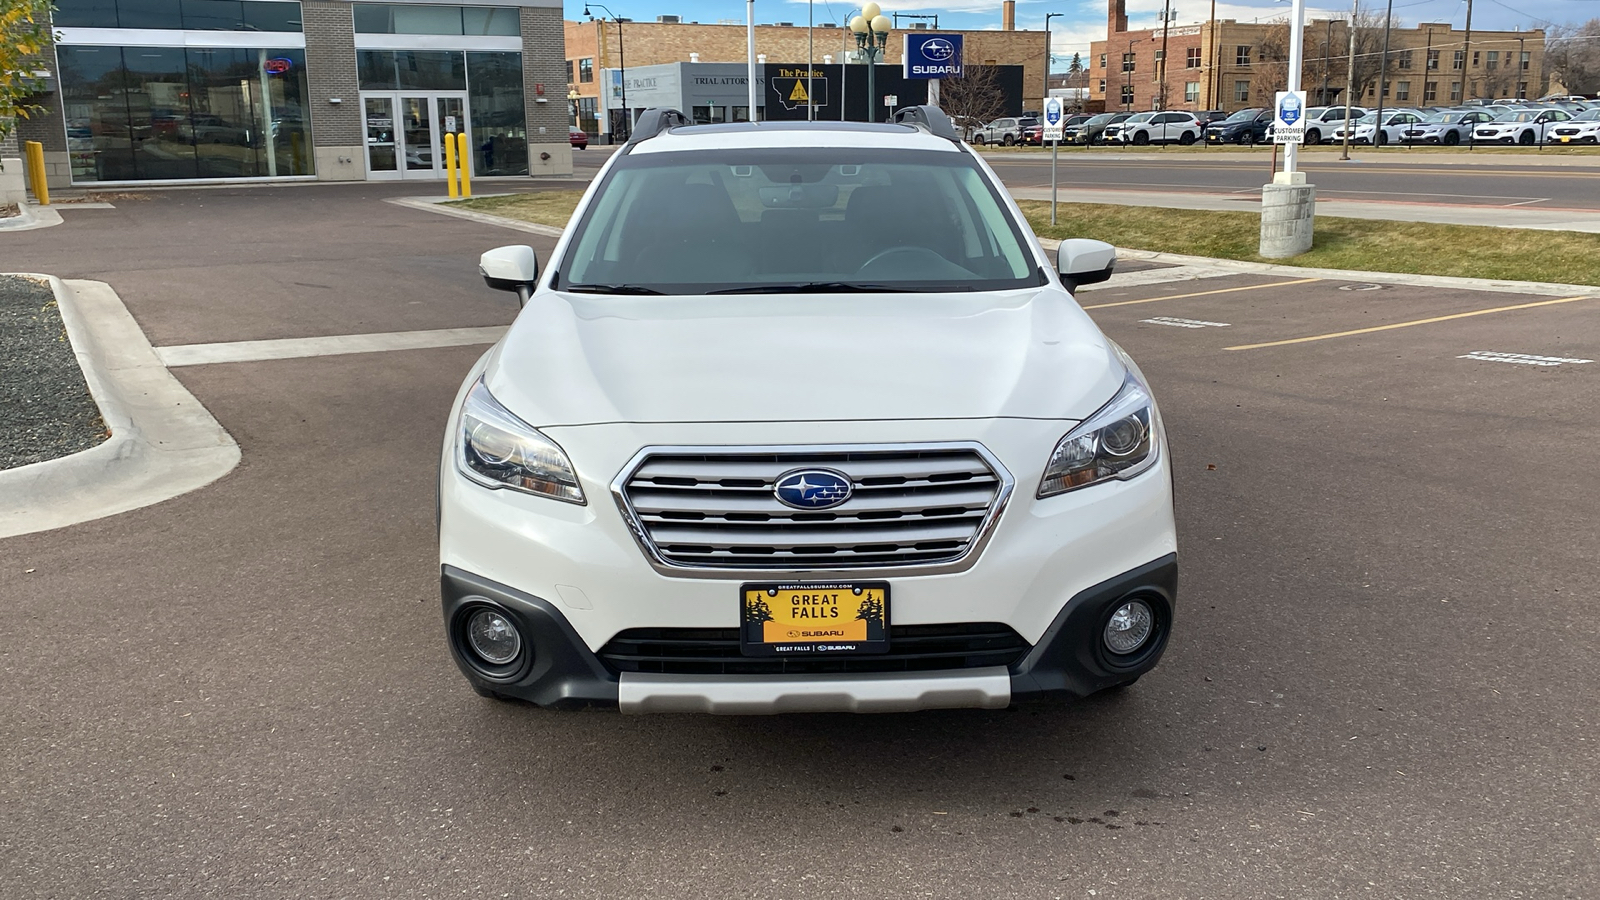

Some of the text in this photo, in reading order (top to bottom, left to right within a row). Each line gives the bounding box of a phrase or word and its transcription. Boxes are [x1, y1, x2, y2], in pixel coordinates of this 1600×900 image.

[779, 68, 824, 77] The Pratice
[912, 65, 960, 74] SUBARU
[633, 77, 657, 89] PRACTICE
[694, 77, 765, 86] TRIAL ATTORNYS
[791, 594, 839, 605] GREAT
[791, 606, 839, 618] FALLS
